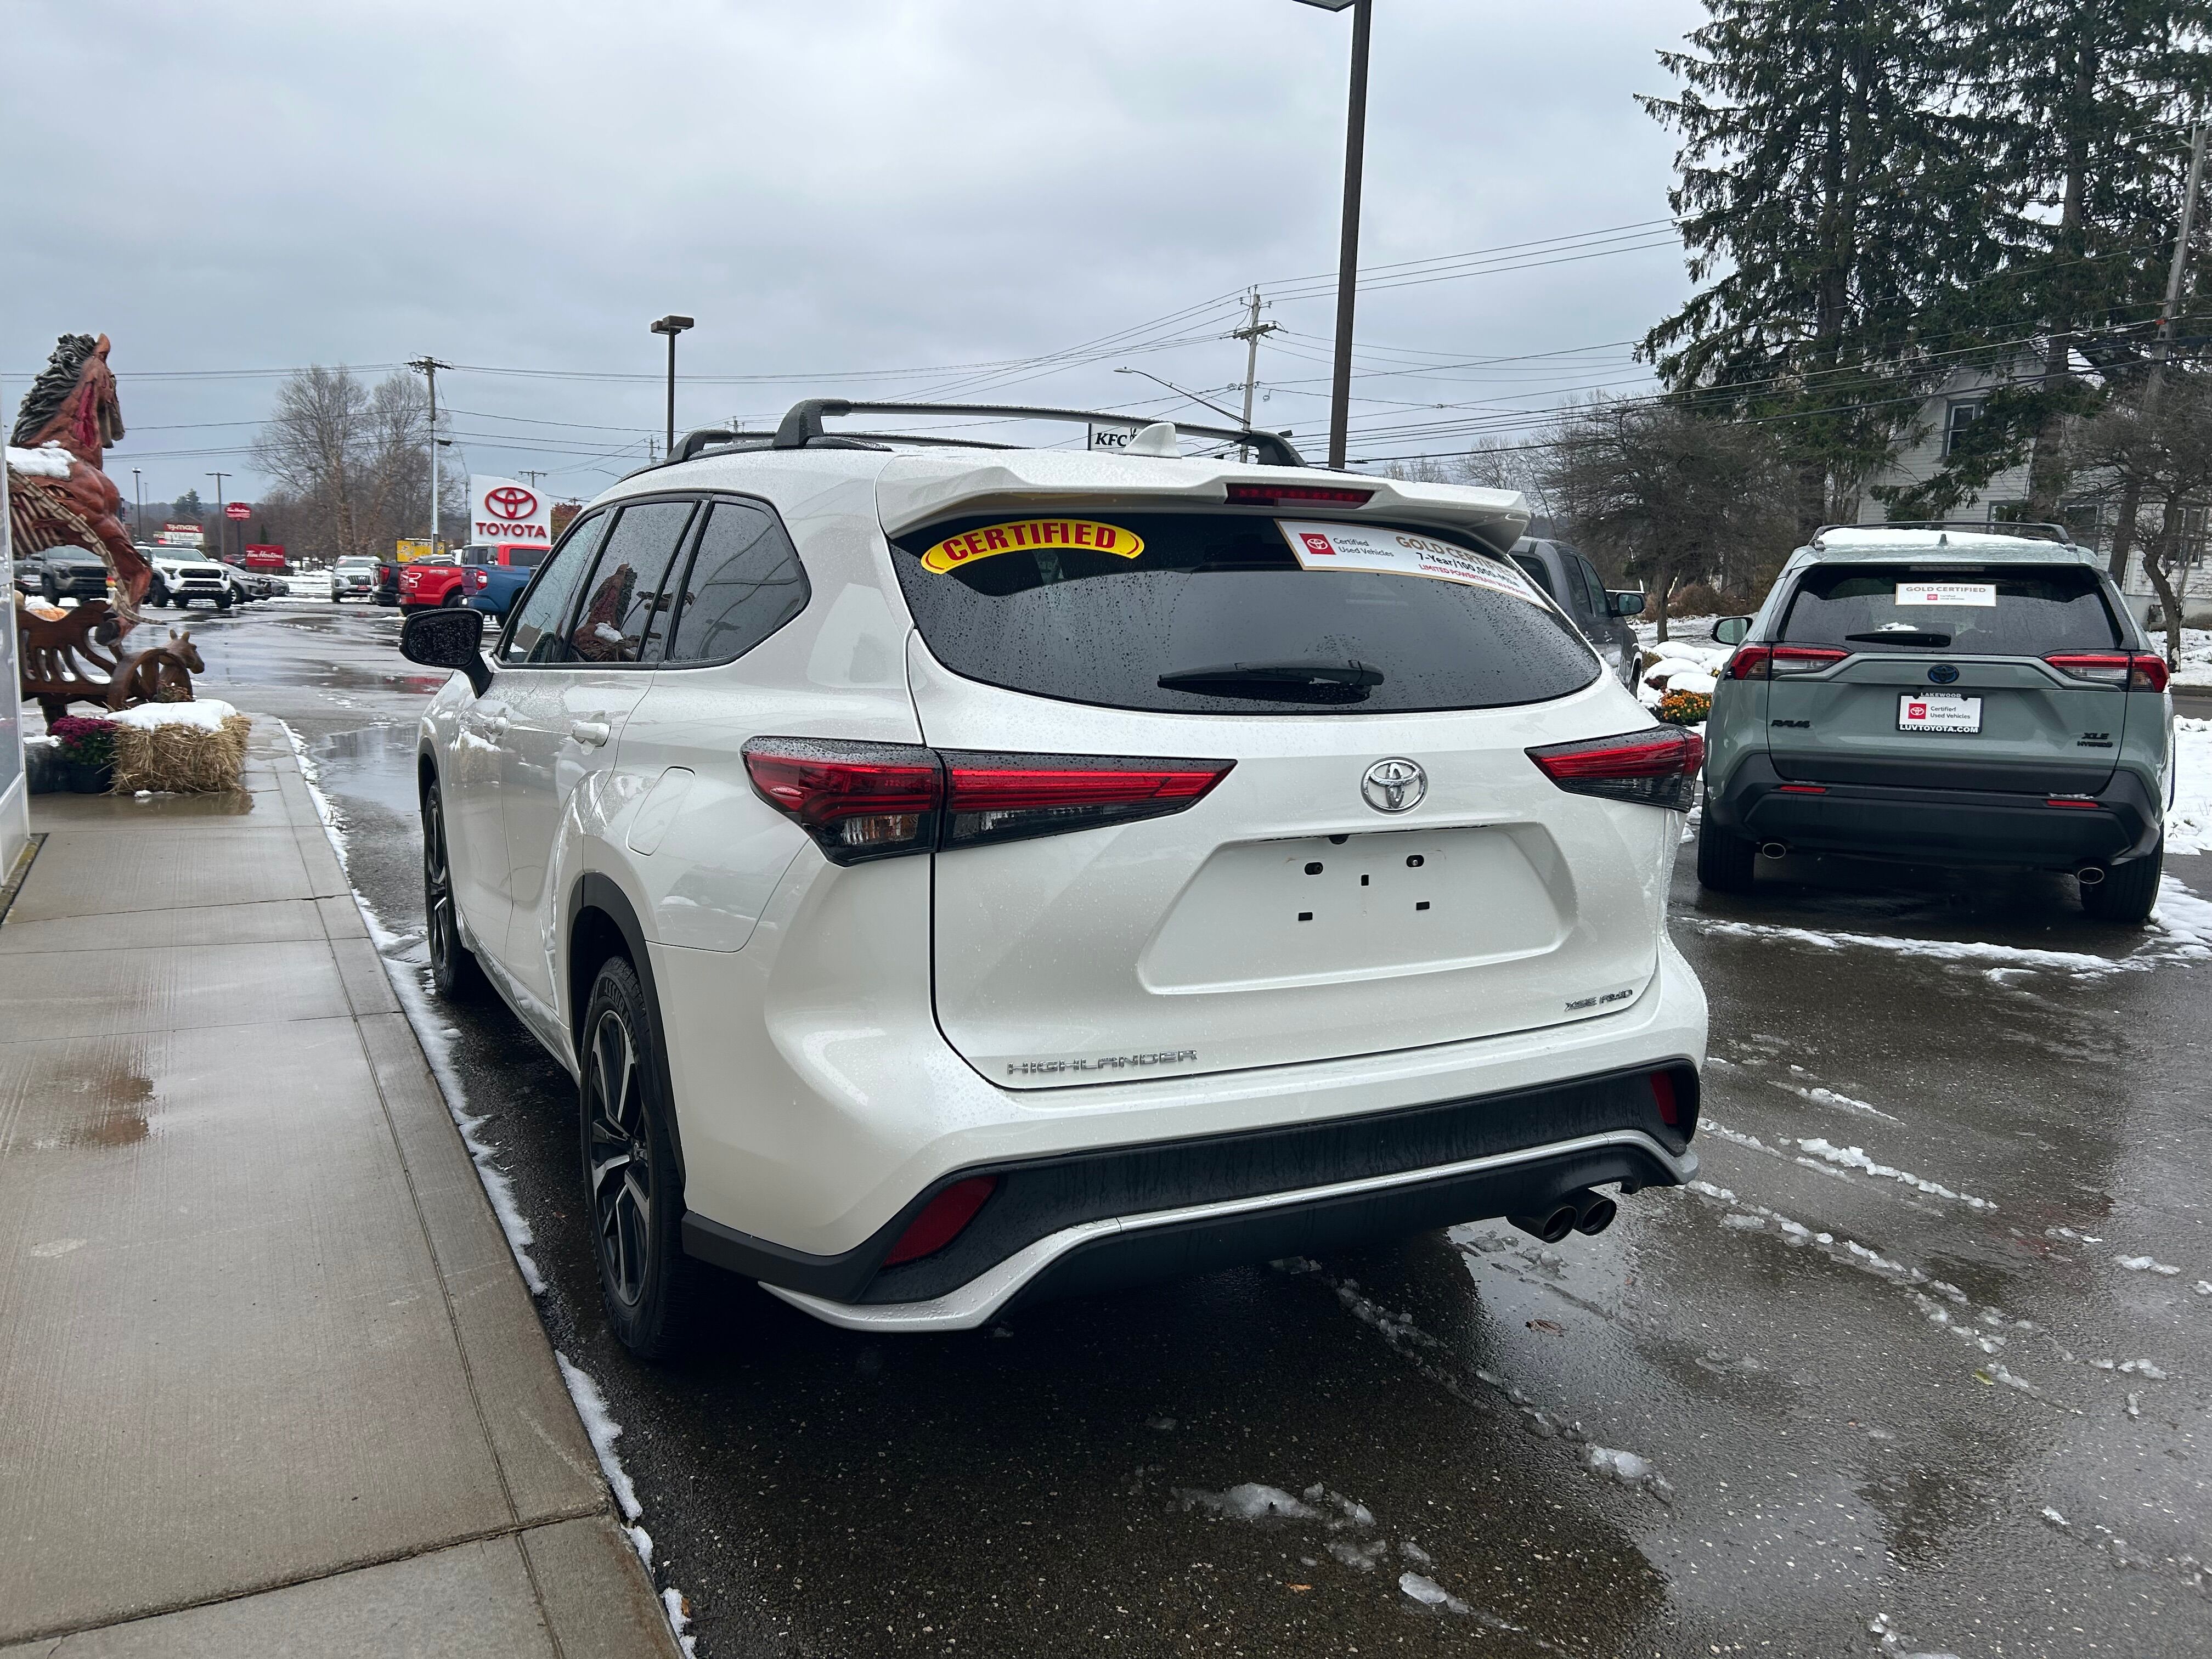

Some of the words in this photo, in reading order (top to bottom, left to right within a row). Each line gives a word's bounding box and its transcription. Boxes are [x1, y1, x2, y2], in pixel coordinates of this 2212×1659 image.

[1095, 432, 1127, 447] KFC
[475, 522, 547, 538] TOYOTA
[942, 522, 1117, 561] CERTIFIED
[1333, 537, 1370, 547] Certified
[258, 550, 284, 559] Hortons
[1361, 548, 1395, 557] Vehicles
[1396, 536, 1445, 555] GOLD
[1446, 547, 1519, 580] CERTIFIED
[1419, 564, 1449, 574] LIMITED
[1900, 724, 1978, 733] LUVTOYOTA.COM
[1565, 996, 1597, 1012] XSE
[1599, 988, 1633, 1005] AWD
[1007, 1049, 1198, 1075] HIGHLANDER
